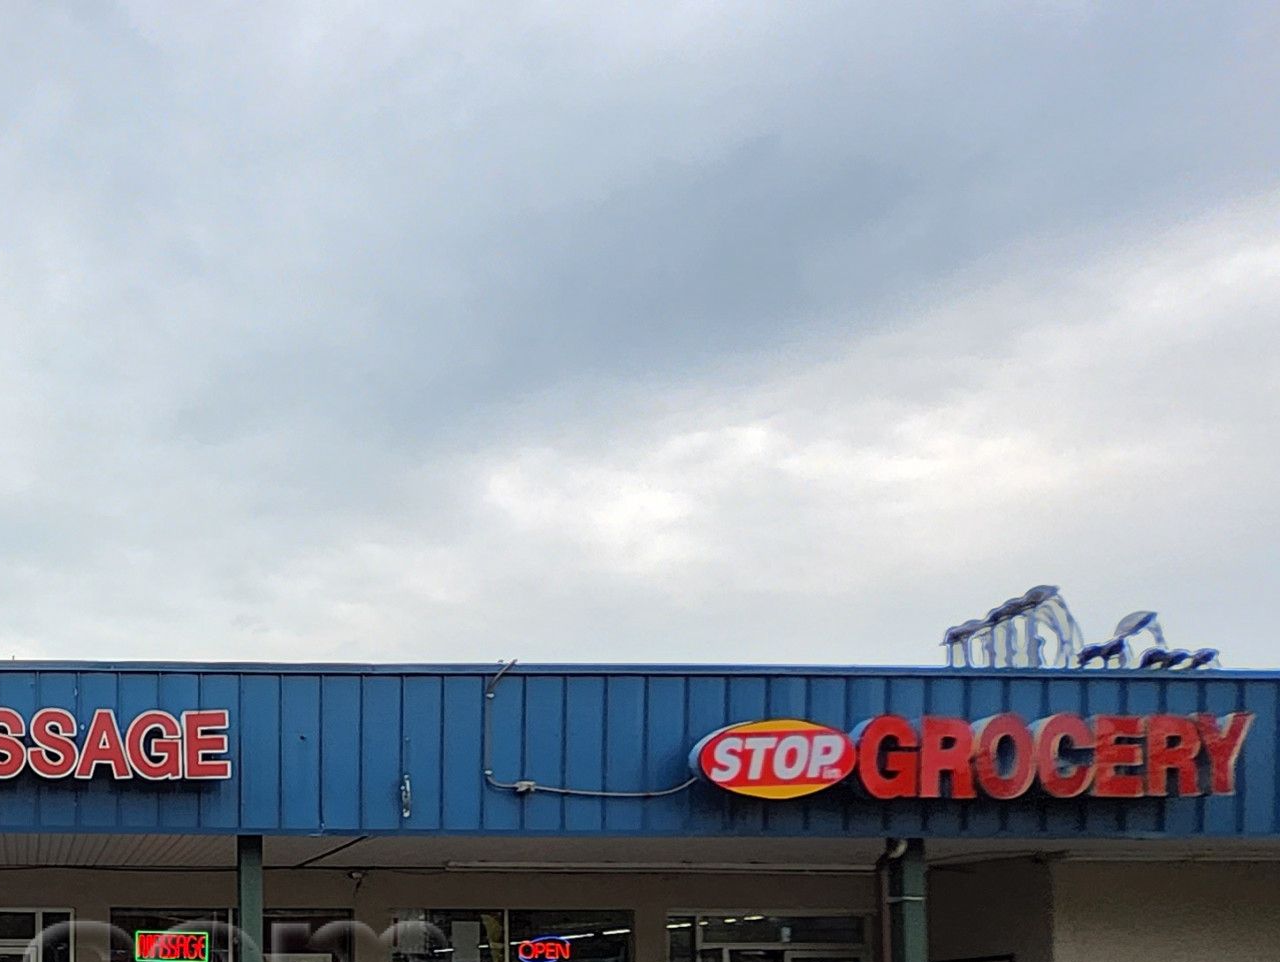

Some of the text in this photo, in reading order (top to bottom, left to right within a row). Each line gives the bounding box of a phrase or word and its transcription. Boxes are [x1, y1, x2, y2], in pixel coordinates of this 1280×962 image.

[710, 711, 1255, 799] STOP GROCERY
[138, 933, 205, 959] MASSAGE
[518, 941, 571, 959] OPEN
